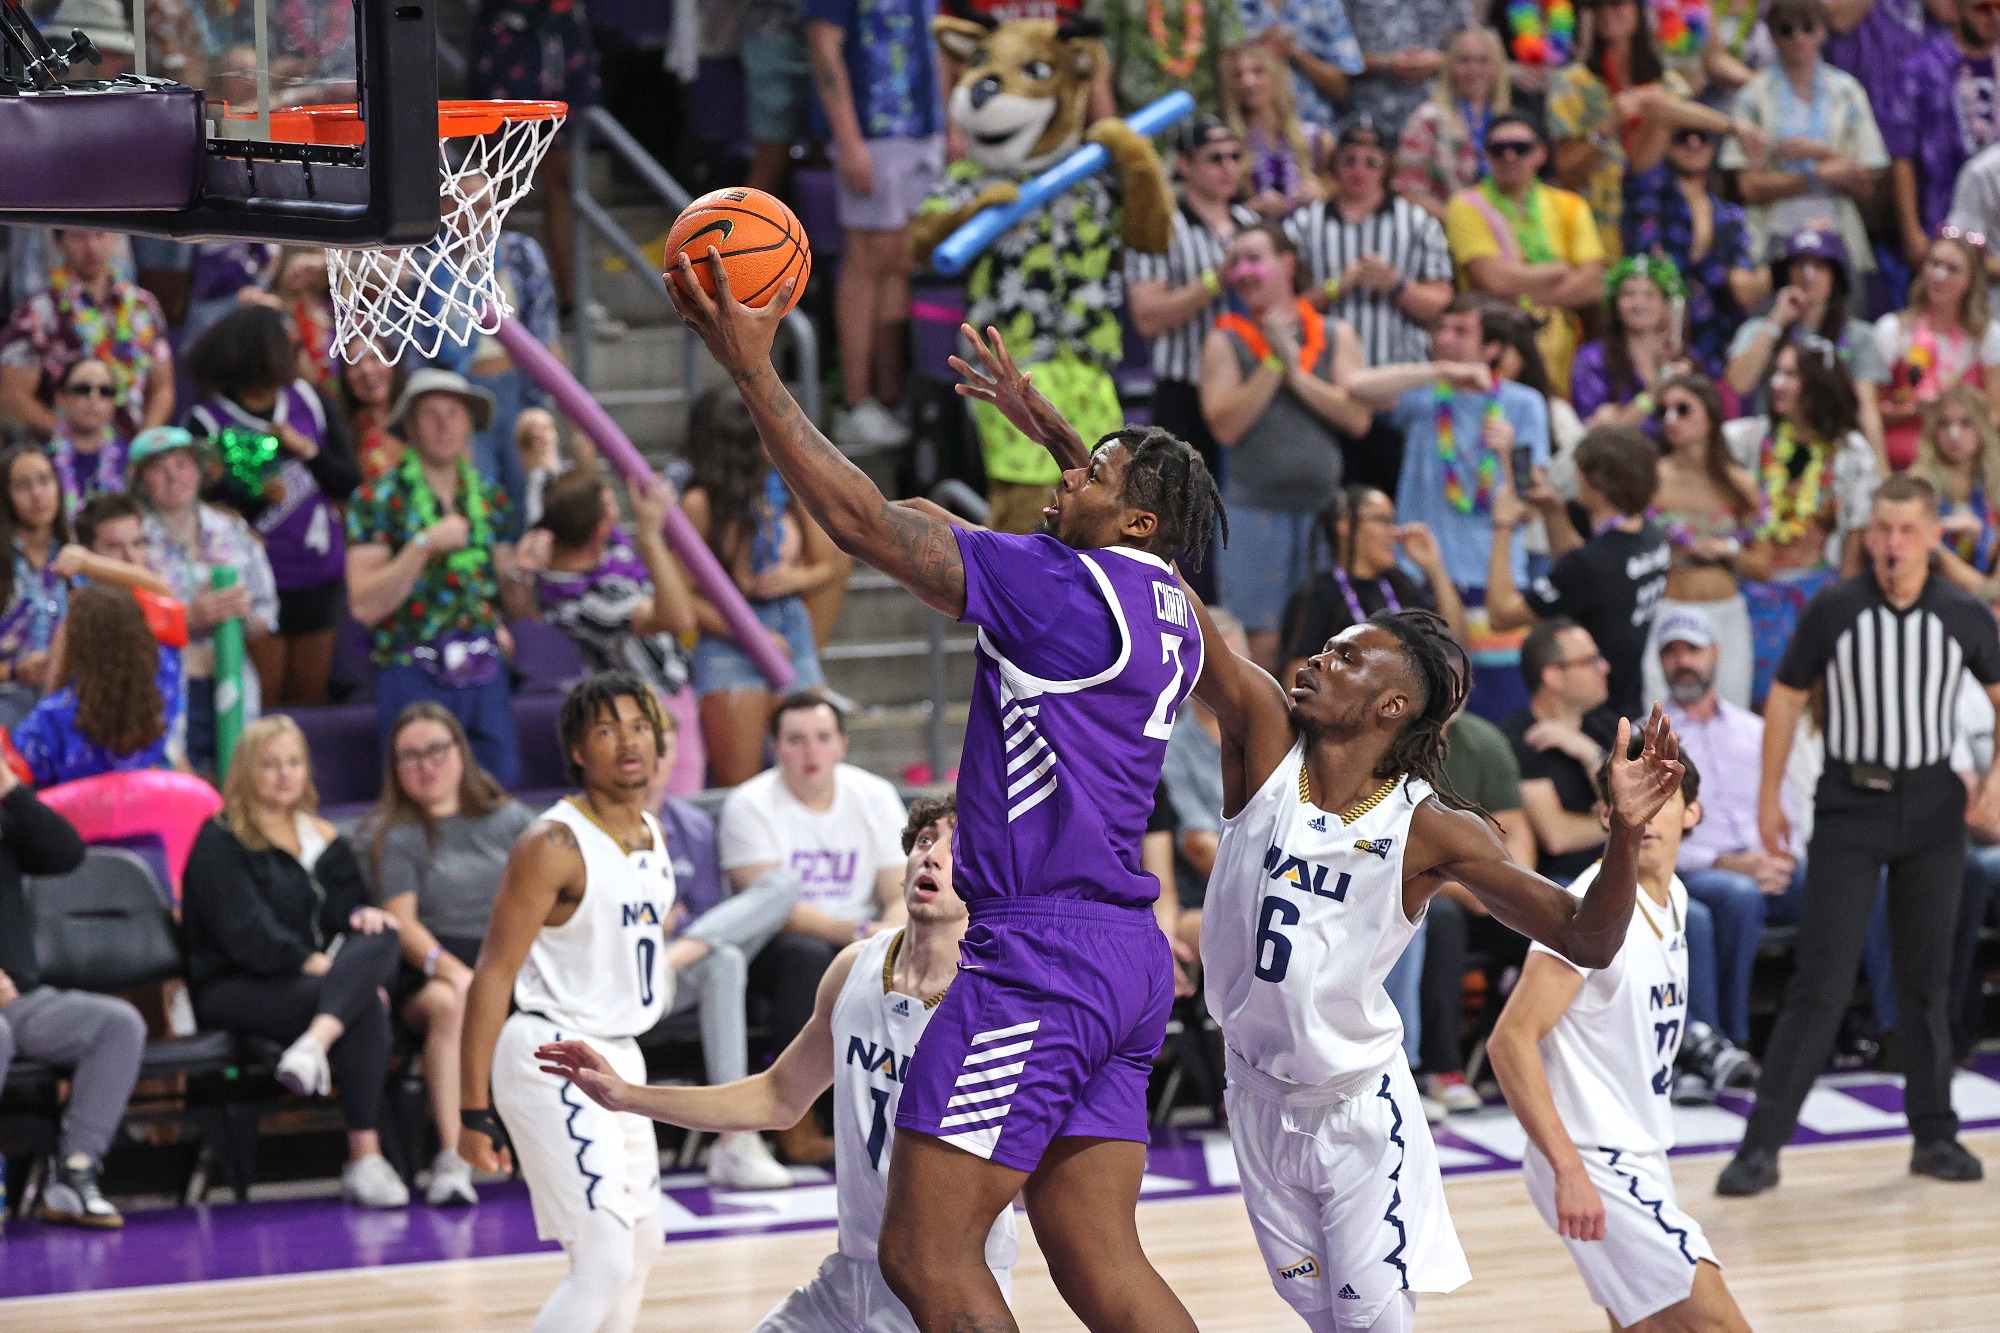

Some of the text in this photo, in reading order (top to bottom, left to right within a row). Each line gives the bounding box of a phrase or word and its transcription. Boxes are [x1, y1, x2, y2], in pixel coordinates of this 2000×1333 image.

[1152, 580, 1189, 629] CURRY
[1142, 631, 1185, 741] 2
[1306, 820, 1327, 833] adidas
[622, 902, 665, 926] NA
[1254, 895, 1301, 984] 6
[637, 938, 655, 1007] 0
[1281, 1262, 1315, 1280] NAU
